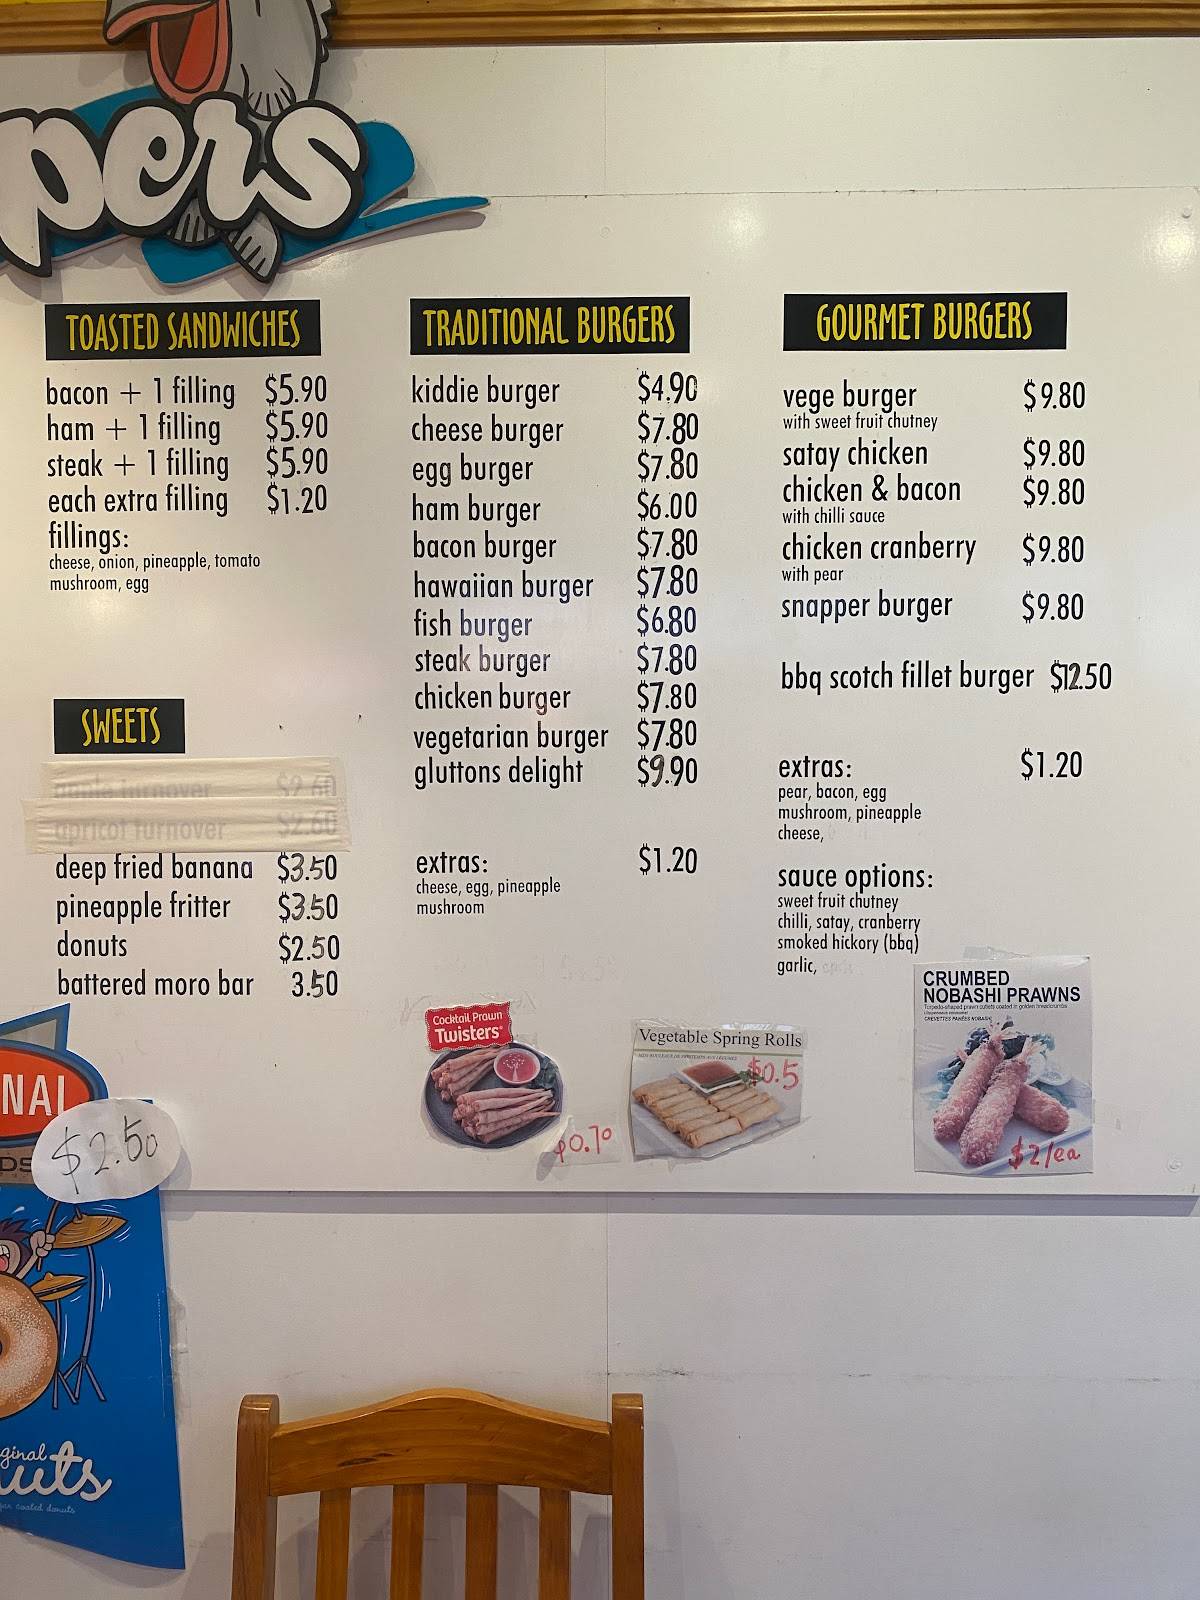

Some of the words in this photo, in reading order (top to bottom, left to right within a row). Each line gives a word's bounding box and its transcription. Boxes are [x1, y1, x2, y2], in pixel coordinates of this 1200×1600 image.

[66, 312, 159, 352] TOASTED
[168, 309, 300, 350] SANDWICHES
[423, 308, 569, 347] TRADITIONAL
[577, 305, 675, 344] BURGERS
[817, 303, 924, 341] GOURMET
[933, 301, 1032, 340] BURGERS
[47, 378, 107, 405] bacon
[154, 378, 161, 403] 1
[173, 376, 234, 409] filling
[266, 373, 326, 406] $5.90
[413, 375, 478, 403] kiddie
[488, 375, 559, 409] burger
[638, 371, 697, 404] $4.90
[784, 389, 834, 414] vege
[844, 379, 917, 413] burger
[1024, 379, 1085, 412] $9.80
[48, 413, 93, 440] ham
[140, 414, 146, 439] 1
[158, 412, 220, 445] filling
[266, 410, 327, 442] $5.90
[412, 413, 482, 441] cheese
[492, 414, 563, 448] burger
[638, 410, 698, 445] $7.80
[783, 412, 809, 429] with
[815, 415, 851, 428] sweet
[856, 412, 883, 428] fruit
[888, 411, 937, 431] chutney
[48, 449, 103, 477] steak
[148, 450, 155, 475] 1
[167, 448, 228, 481] filling
[267, 446, 327, 479] $5.90
[413, 463, 451, 487] egg
[461, 452, 533, 486] burger
[638, 448, 698, 482] $7.80
[783, 443, 840, 472] satay
[848, 437, 927, 465] chicken
[1024, 437, 1084, 470] $9.80
[49, 485, 95, 512] each
[105, 490, 157, 512] extra
[166, 484, 227, 517] filling
[267, 482, 326, 514] $1.20
[413, 493, 458, 520] ham
[469, 493, 540, 527] burger
[638, 488, 697, 521] $6.00
[783, 474, 861, 502] chicken
[872, 475, 888, 501] &
[898, 473, 960, 500] bacon
[1024, 475, 1084, 508] $9.80
[783, 507, 809, 523] with
[815, 507, 844, 523] chilli
[850, 512, 884, 523] sauce
[49, 521, 128, 554] fillings:
[414, 530, 475, 558] bacon
[485, 530, 556, 564] burger
[638, 527, 697, 560] $7.80
[783, 532, 861, 560] chicken
[871, 531, 976, 564] cranberry
[1023, 533, 1083, 566] $9.80
[50, 553, 94, 572] cheese,
[99, 558, 138, 571] onion,
[144, 551, 210, 572] pineapple,
[215, 554, 260, 567] tomato
[782, 565, 808, 581] with
[815, 570, 843, 585] pear
[51, 574, 121, 592] mushroom,
[126, 579, 148, 593] egg
[415, 570, 512, 598] hawaiian
[523, 570, 593, 604] burger
[637, 565, 697, 599] $7.80
[414, 609, 451, 636] fish
[461, 609, 532, 642] burger
[637, 604, 696, 637] $6.80
[782, 599, 870, 623] snapper
[879, 589, 952, 622] burger
[1023, 591, 1083, 623] $9.80
[416, 644, 470, 672] steak
[480, 644, 550, 677] burger
[637, 642, 696, 675] $7.80
[782, 662, 821, 695] bbq
[830, 661, 892, 688] scotch
[902, 660, 952, 688] fillet
[960, 660, 1034, 694] burger
[1051, 660, 1111, 693] $12.50
[415, 682, 491, 709] chicken
[500, 682, 570, 715] burger
[638, 680, 696, 713] $7.80
[82, 707, 160, 747] SWEETS
[414, 724, 528, 754] vegetarian
[538, 721, 608, 754] burger
[638, 718, 696, 751] $7.80
[415, 757, 500, 790] gluttons
[509, 756, 583, 789] delight
[638, 754, 697, 787] $9.90
[779, 756, 851, 777] extras:
[1021, 748, 1082, 781] $1.20
[779, 788, 811, 802] pear,
[817, 782, 857, 801] bacon,
[863, 788, 886, 802] egg
[779, 803, 851, 822] mushroom,
[857, 803, 921, 823] pineapple
[779, 824, 823, 842] cheese,
[56, 854, 106, 885] deep
[114, 853, 163, 879] fried
[172, 854, 253, 879] banana
[277, 852, 337, 884] $3.50
[417, 852, 487, 873] extras:
[640, 843, 697, 875] $1.20
[417, 878, 461, 896] cheese,
[466, 883, 493, 897] egg,
[498, 876, 560, 896] pineapple
[779, 869, 836, 887] sauce
[846, 863, 932, 894] options:
[57, 891, 161, 924] pineapple
[170, 891, 230, 918] fritter
[279, 891, 337, 923] $3.50
[417, 898, 484, 914] mushroom
[778, 895, 813, 907] sweet
[818, 892, 845, 907] fruit
[850, 892, 898, 912] chutney
[778, 912, 811, 931] chilli,
[817, 916, 853, 932] satay,
[859, 913, 920, 933] cranberry
[58, 930, 127, 956] donuts
[279, 932, 339, 964] $2.50
[778, 933, 827, 949] smoked
[833, 933, 878, 953] hickory
[884, 933, 918, 954] (bbq)
[778, 956, 816, 975] garlic,
[923, 971, 1009, 986] CRUMBED
[58, 968, 145, 995] battered
[155, 978, 209, 995] moro
[219, 969, 253, 995] bar
[292, 970, 337, 998] 3.50
[924, 988, 1001, 1003] NOBASHI
[1008, 987, 1080, 1002] PRAWNS
[433, 1013, 471, 1026] Cocktail
[473, 1011, 503, 1022] Prawn
[640, 1029, 708, 1045] Vegetable
[713, 1031, 759, 1048] Spring
[765, 1033, 801, 1047] Rolls
[747, 1056, 799, 1090] $0.5
[52, 1116, 157, 1194] $2.50
